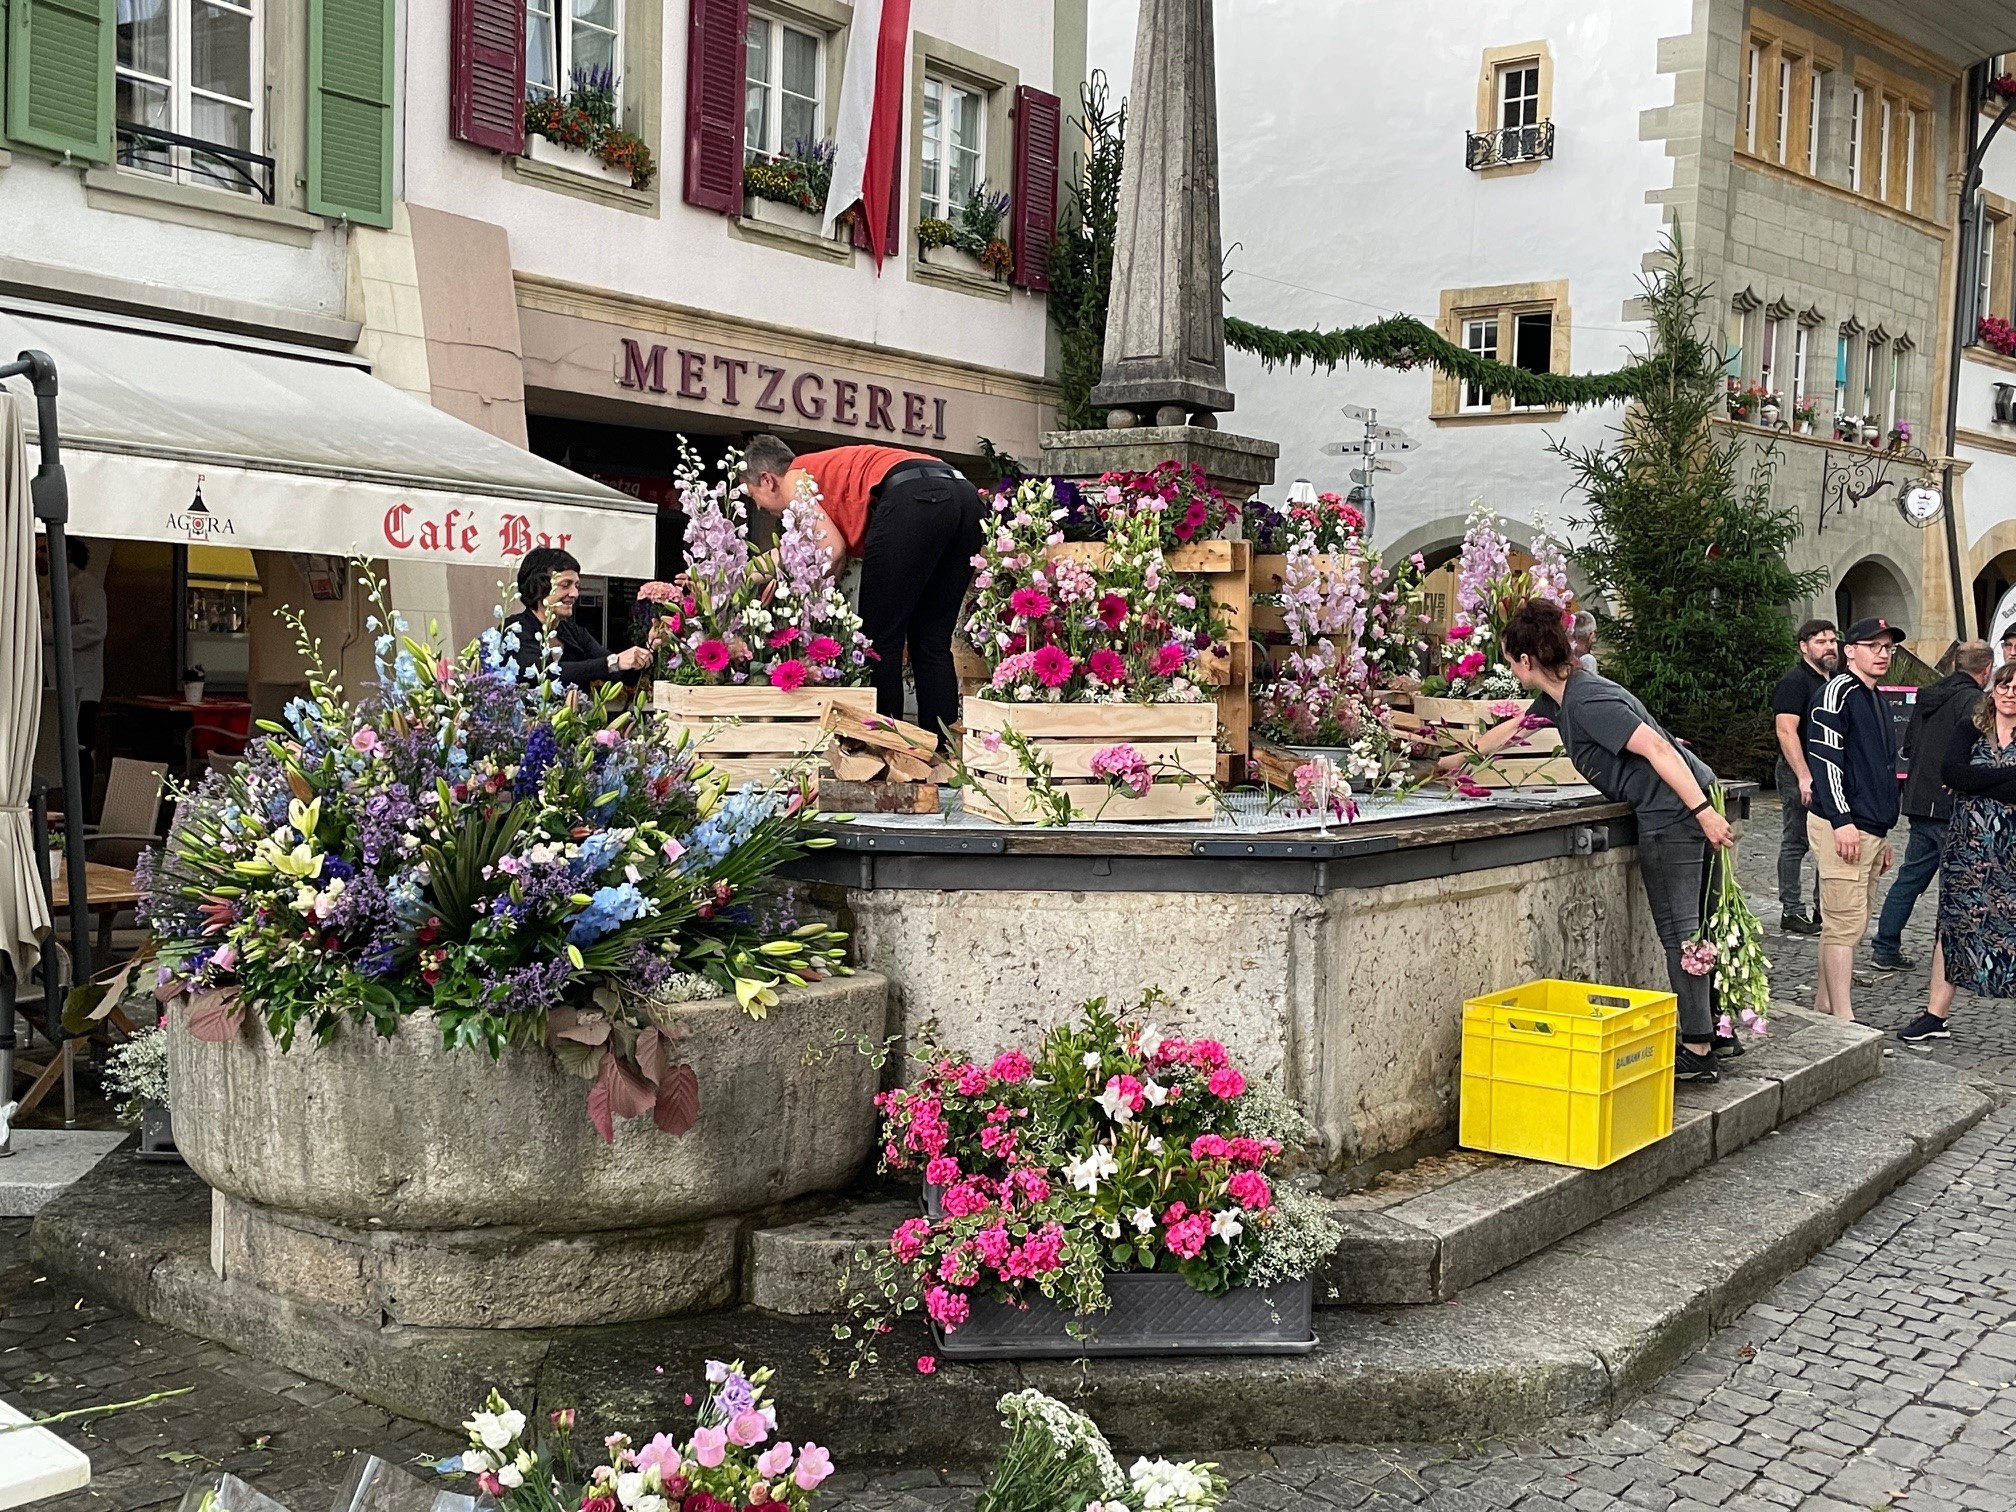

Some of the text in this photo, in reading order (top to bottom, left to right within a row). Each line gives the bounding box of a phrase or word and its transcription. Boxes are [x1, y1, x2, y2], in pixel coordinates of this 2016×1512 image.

[620, 337, 947, 439] METZGEREI
[166, 512, 235, 534] AGORA
[384, 503, 572, 558] Café Bar
